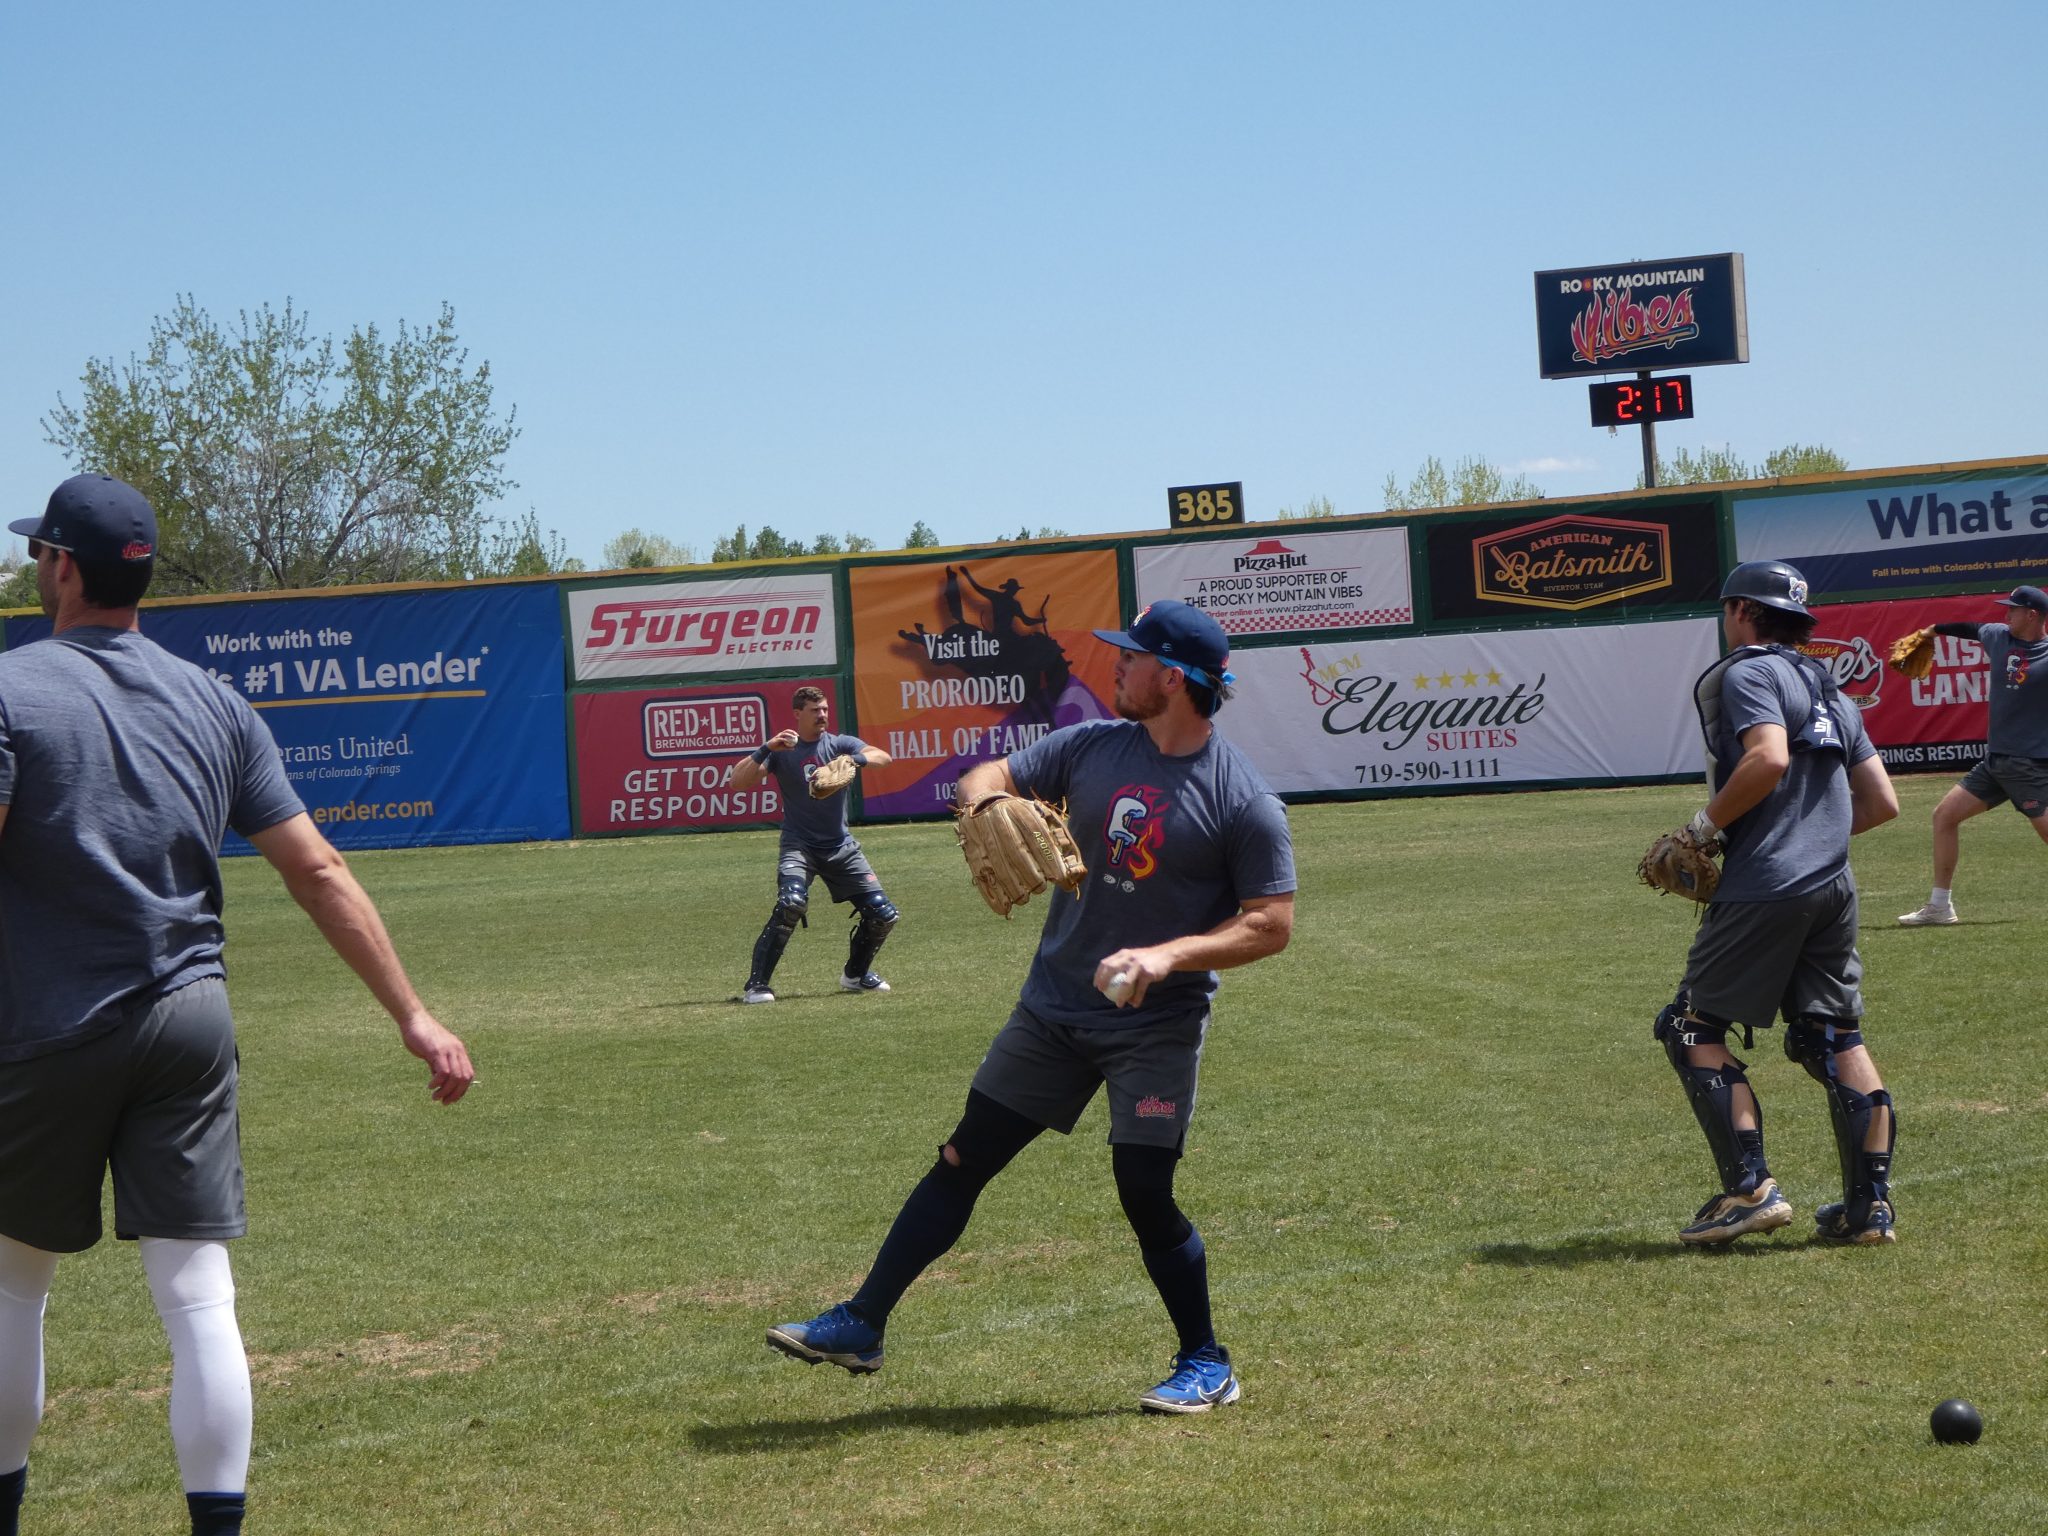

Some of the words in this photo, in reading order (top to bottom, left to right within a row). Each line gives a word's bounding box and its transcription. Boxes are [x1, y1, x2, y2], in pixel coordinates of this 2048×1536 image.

[1616, 268, 1705, 289] MOUNTAIN
[1617, 381, 1683, 419] 2:17
[1176, 489, 1234, 522] 385
[1867, 490, 2013, 540] What
[1530, 533, 1613, 552] AMERICAN
[1494, 541, 1654, 590] Batsmith
[1872, 568, 1889, 577] Fall
[1890, 568, 1900, 576] in
[1901, 567, 1920, 576] love
[1922, 564, 1942, 574] with
[1943, 561, 1992, 572] Colorado's
[1994, 558, 2019, 569] small
[1199, 581, 1208, 593] A
[1210, 578, 1253, 592] PROUD
[1256, 574, 1327, 588] SUPPORTER
[1331, 571, 1348, 584] OF
[1583, 582, 1604, 590] UTAH
[1184, 596, 1207, 609] THE
[1210, 593, 1254, 607] ROCKY
[1258, 588, 1326, 604] MOUNTAIN
[1329, 585, 1363, 599] VIBES
[1230, 608, 1253, 617] online
[1266, 602, 1354, 614] www.pizzahut.com
[206, 632, 262, 654] Work
[267, 629, 312, 650] with
[317, 627, 353, 647] the
[585, 603, 821, 656] Sturgeon
[725, 639, 814, 655] ELECTRIC
[924, 632, 966, 660] Visit
[971, 630, 1000, 657] the
[244, 662, 284, 694] #1
[294, 658, 347, 692] VA
[900, 673, 1026, 710] PRORODEO
[653, 707, 700, 738] RED
[710, 704, 756, 735] LEG
[1321, 673, 1546, 751] Eleganté
[655, 737, 704, 749] BREWING
[705, 734, 757, 747] COMPANY
[888, 728, 948, 760] HALL
[953, 726, 984, 756] OF
[1426, 728, 1518, 752] SUITES
[277, 744, 332, 763] erans
[1877, 747, 1925, 763] RINGS
[1927, 744, 1990, 761] RESTAU
[286, 769, 304, 780] ans
[306, 767, 318, 781] of
[318, 765, 363, 779] Colorado
[364, 763, 401, 779] Springs
[624, 767, 678, 793] GET
[682, 764, 768, 789] TOA
[1354, 758, 1501, 784] 719-590-1111
[313, 800, 434, 824] ender.com
[610, 790, 784, 822] RESPONSIB
